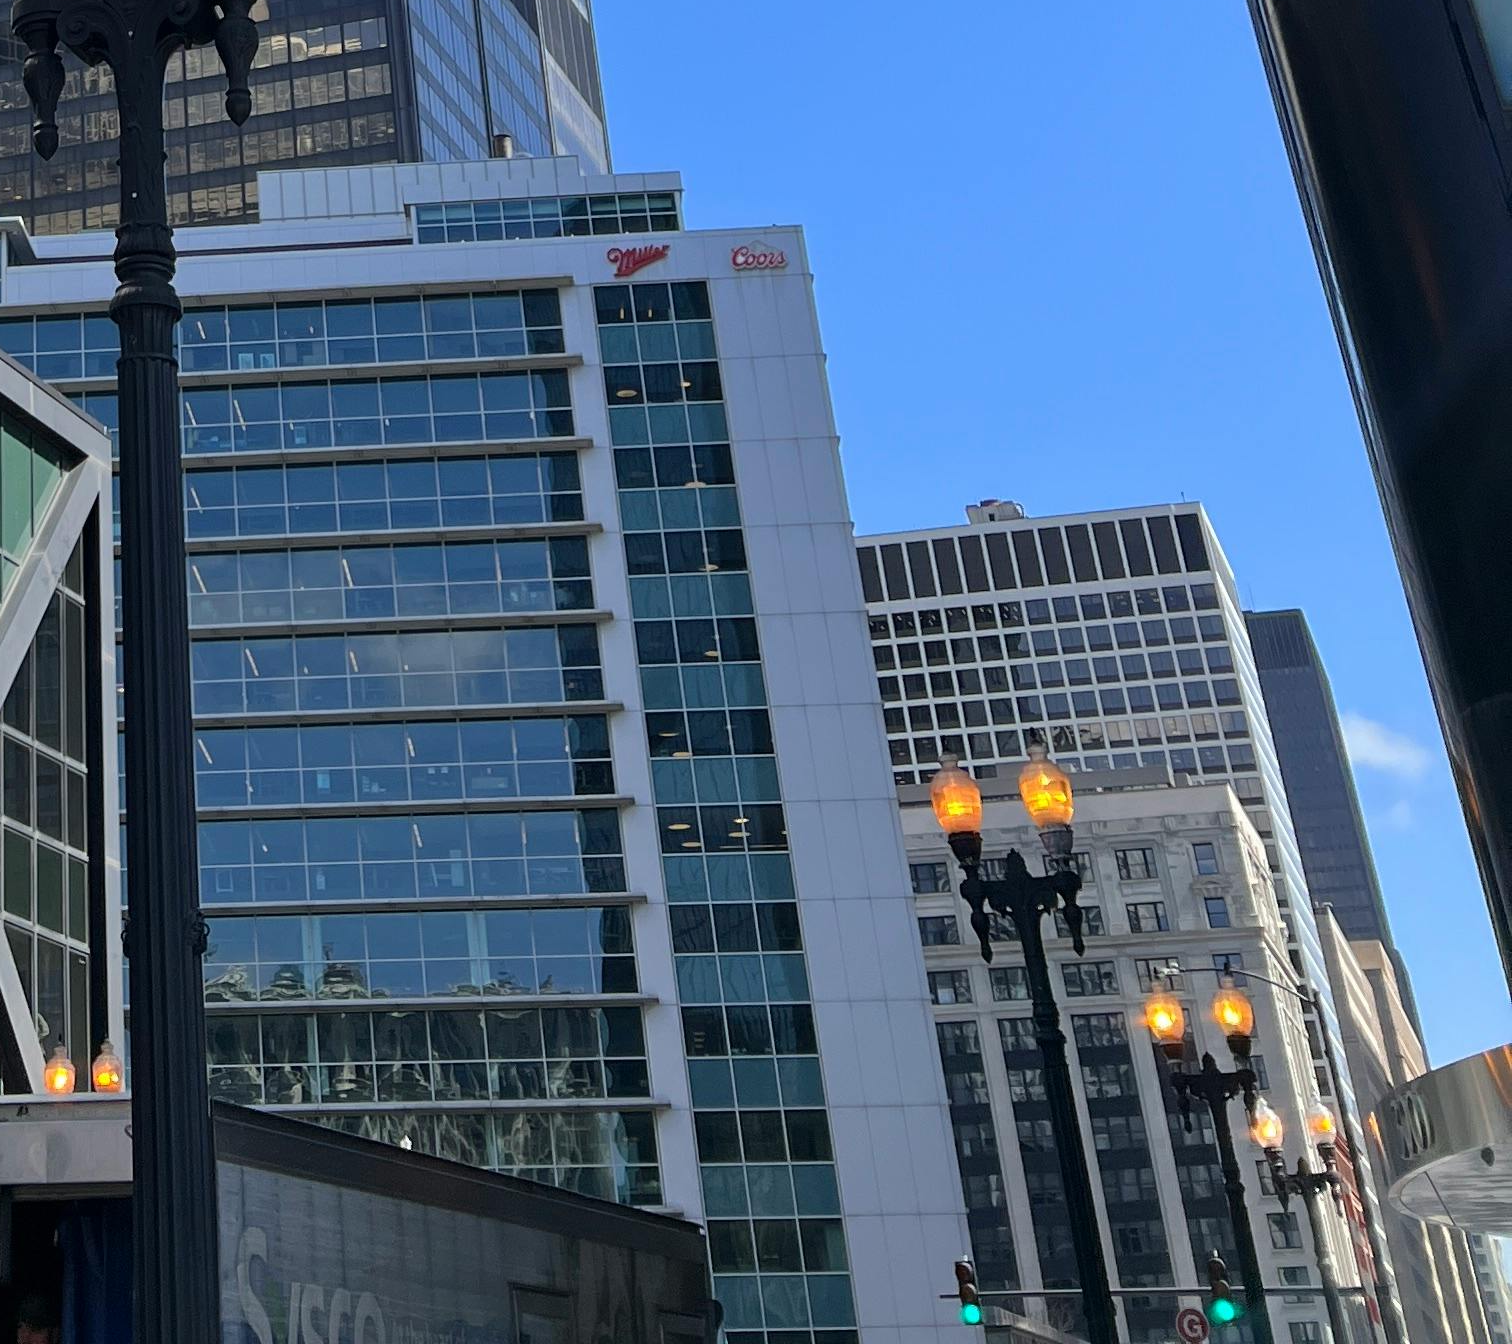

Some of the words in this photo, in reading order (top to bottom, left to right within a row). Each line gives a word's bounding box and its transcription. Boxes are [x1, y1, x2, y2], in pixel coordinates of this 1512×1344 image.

[607, 243, 671, 277] Miller
[731, 245, 788, 271] Coors
[1183, 1314, 1203, 1338] G
